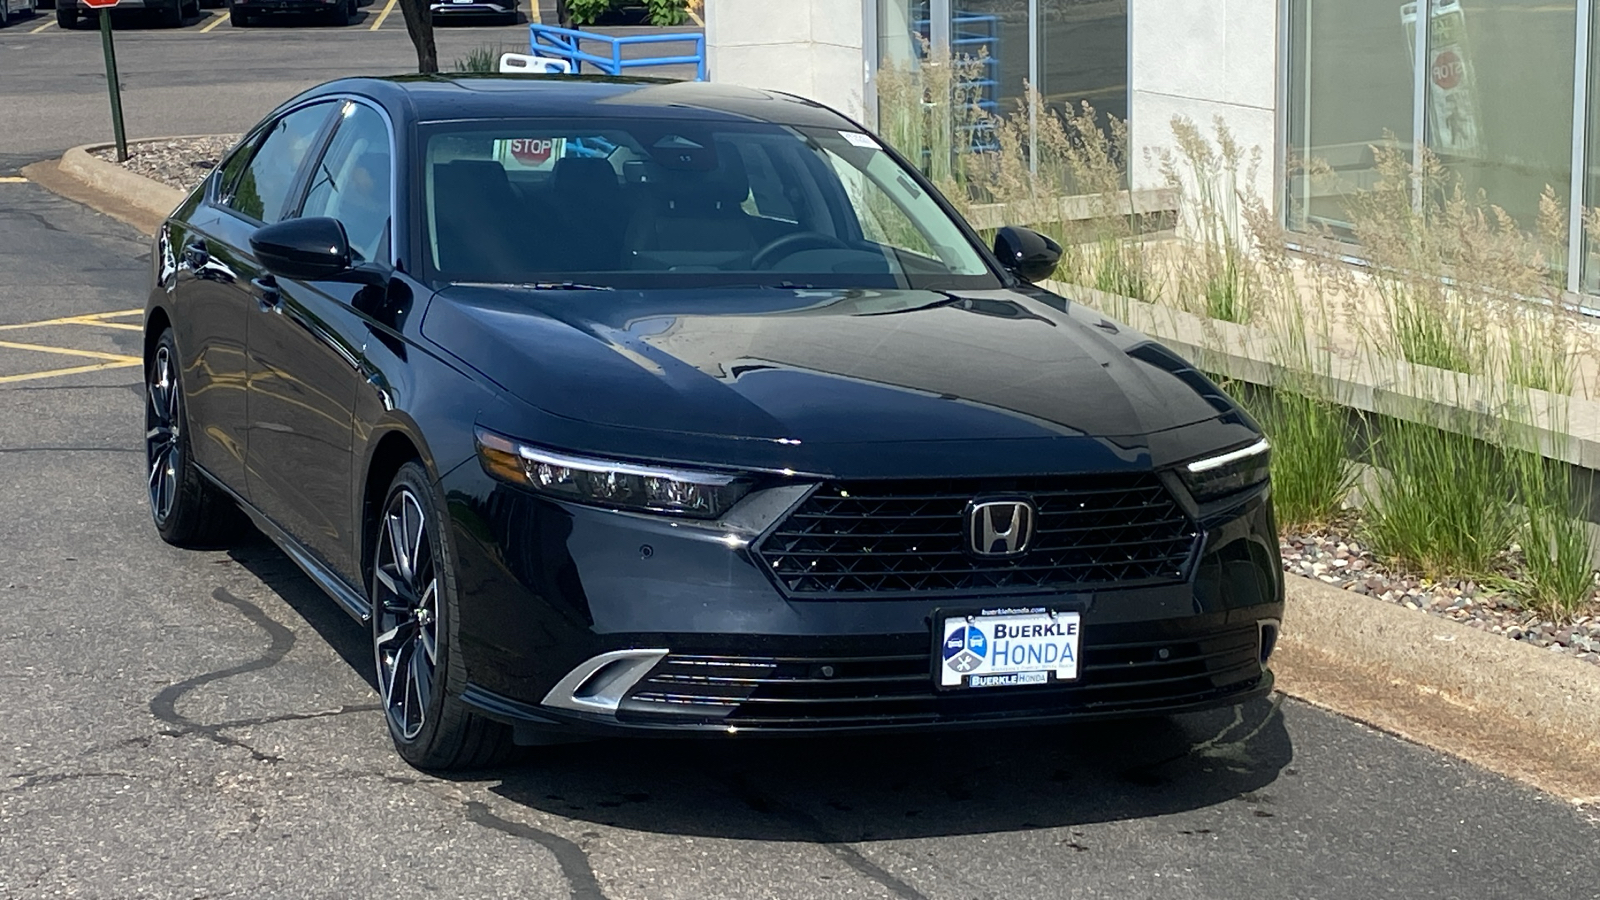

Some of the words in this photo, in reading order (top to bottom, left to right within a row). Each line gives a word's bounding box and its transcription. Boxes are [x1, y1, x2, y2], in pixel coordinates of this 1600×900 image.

[512, 138, 552, 154] STOP
[982, 606, 1046, 616] buerklehonda.com
[993, 623, 1077, 639] BUERKLE
[991, 640, 1074, 666] HONDA
[971, 674, 1017, 686] BUERKLE
[1018, 674, 1046, 684] HONDA
